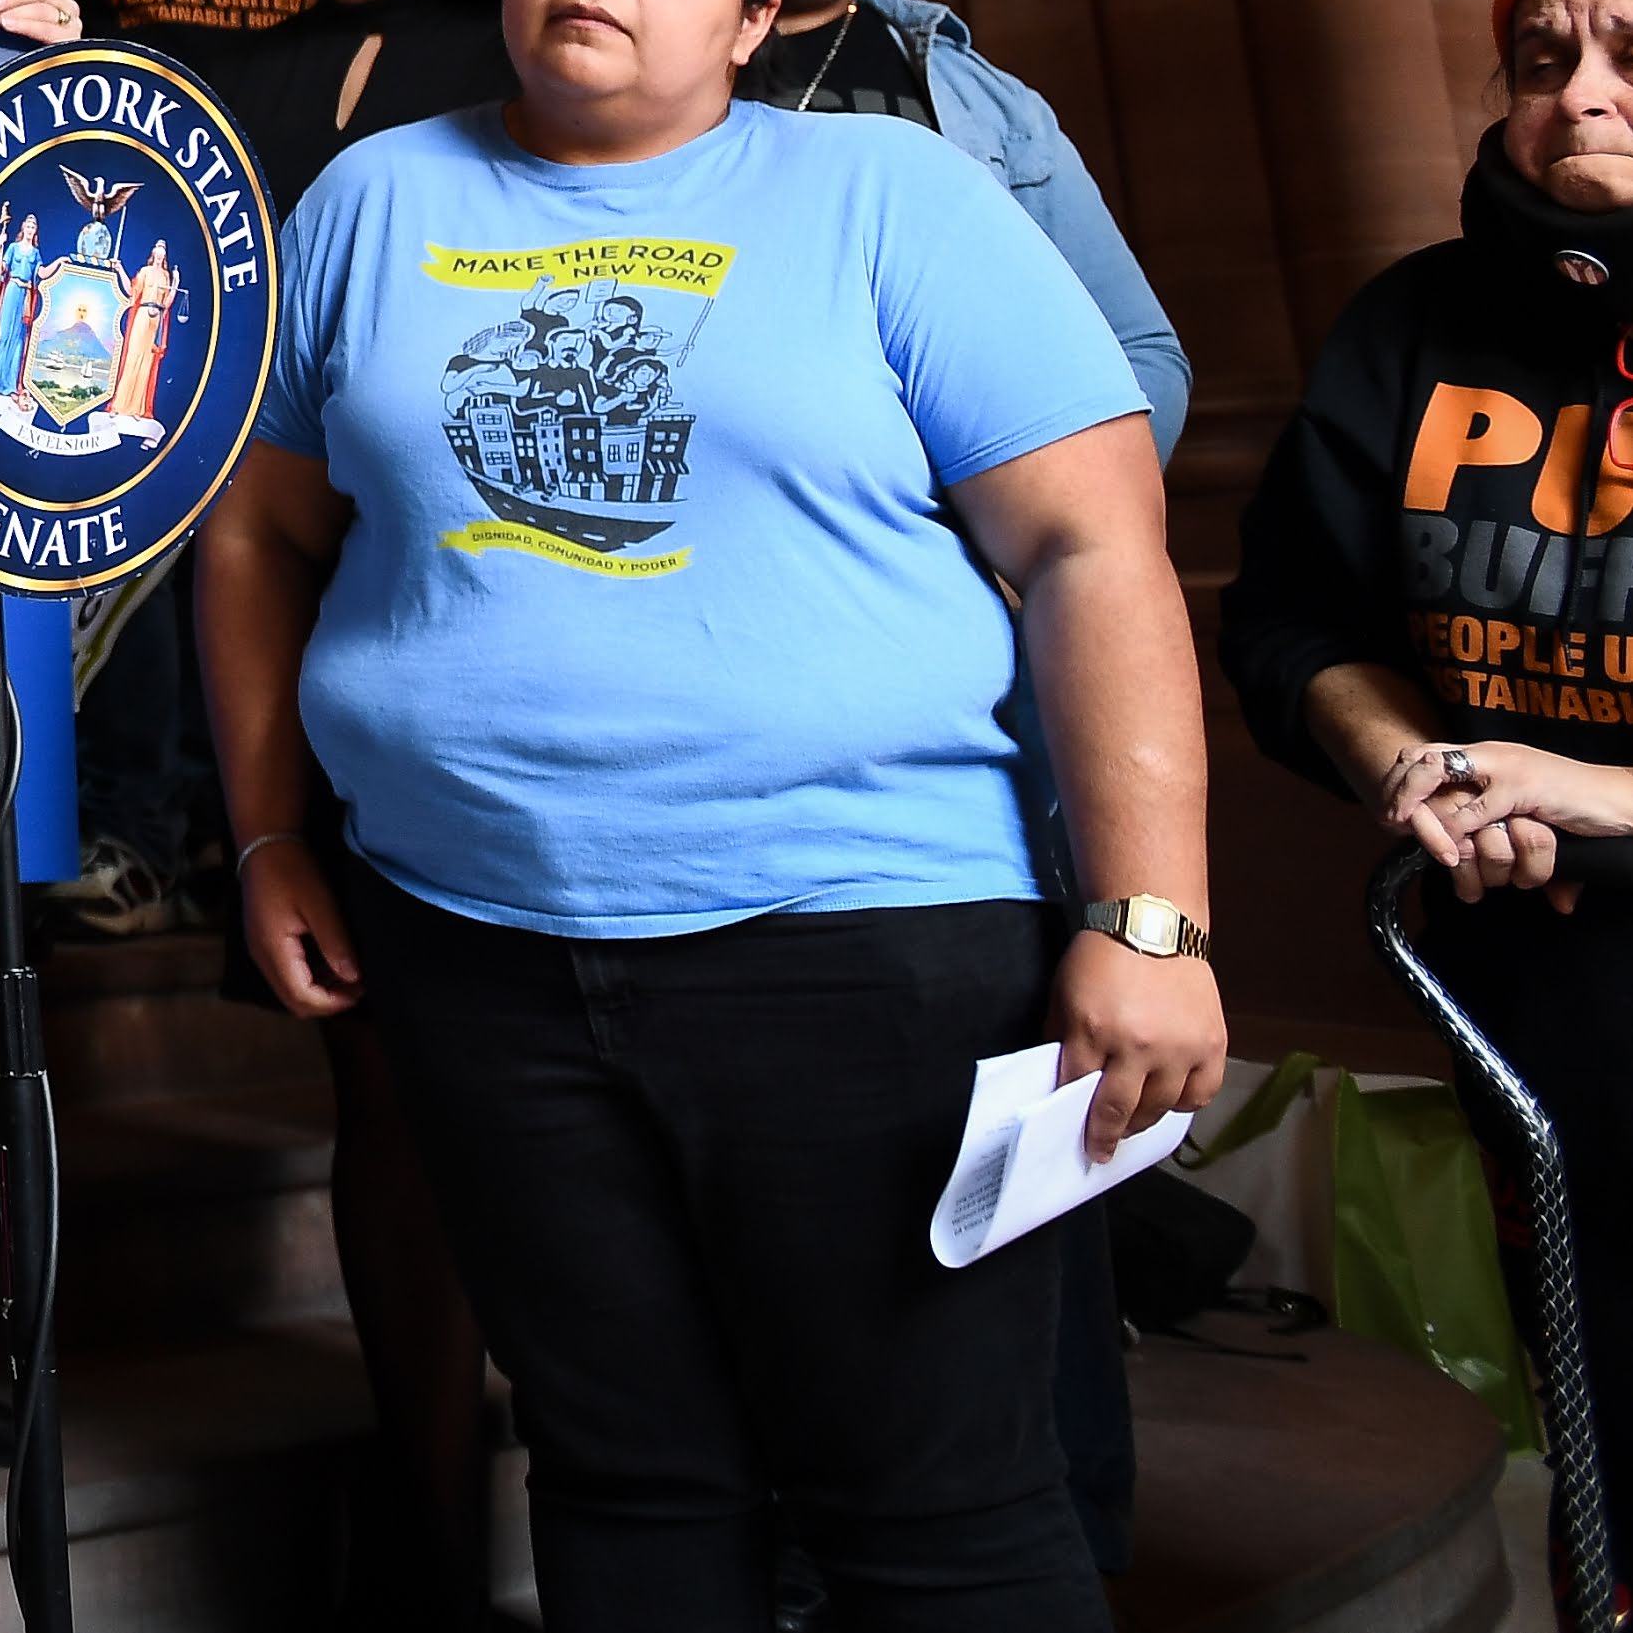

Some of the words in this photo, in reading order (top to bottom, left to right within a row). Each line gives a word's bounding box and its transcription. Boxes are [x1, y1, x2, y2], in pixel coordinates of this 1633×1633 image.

[37, 73, 182, 149] YORK
[175, 126, 259, 293] STATE
[452, 256, 545, 274] MAKE
[552, 244, 620, 266] THE
[627, 243, 724, 269] ROAD
[572, 262, 637, 279] NEW
[646, 264, 714, 286] YORK
[16, 424, 101, 451] EXCELSIOR
[537, 540, 615, 571] COMUNIDAD
[618, 561, 627, 572] Y
[630, 557, 678, 572] PODER
